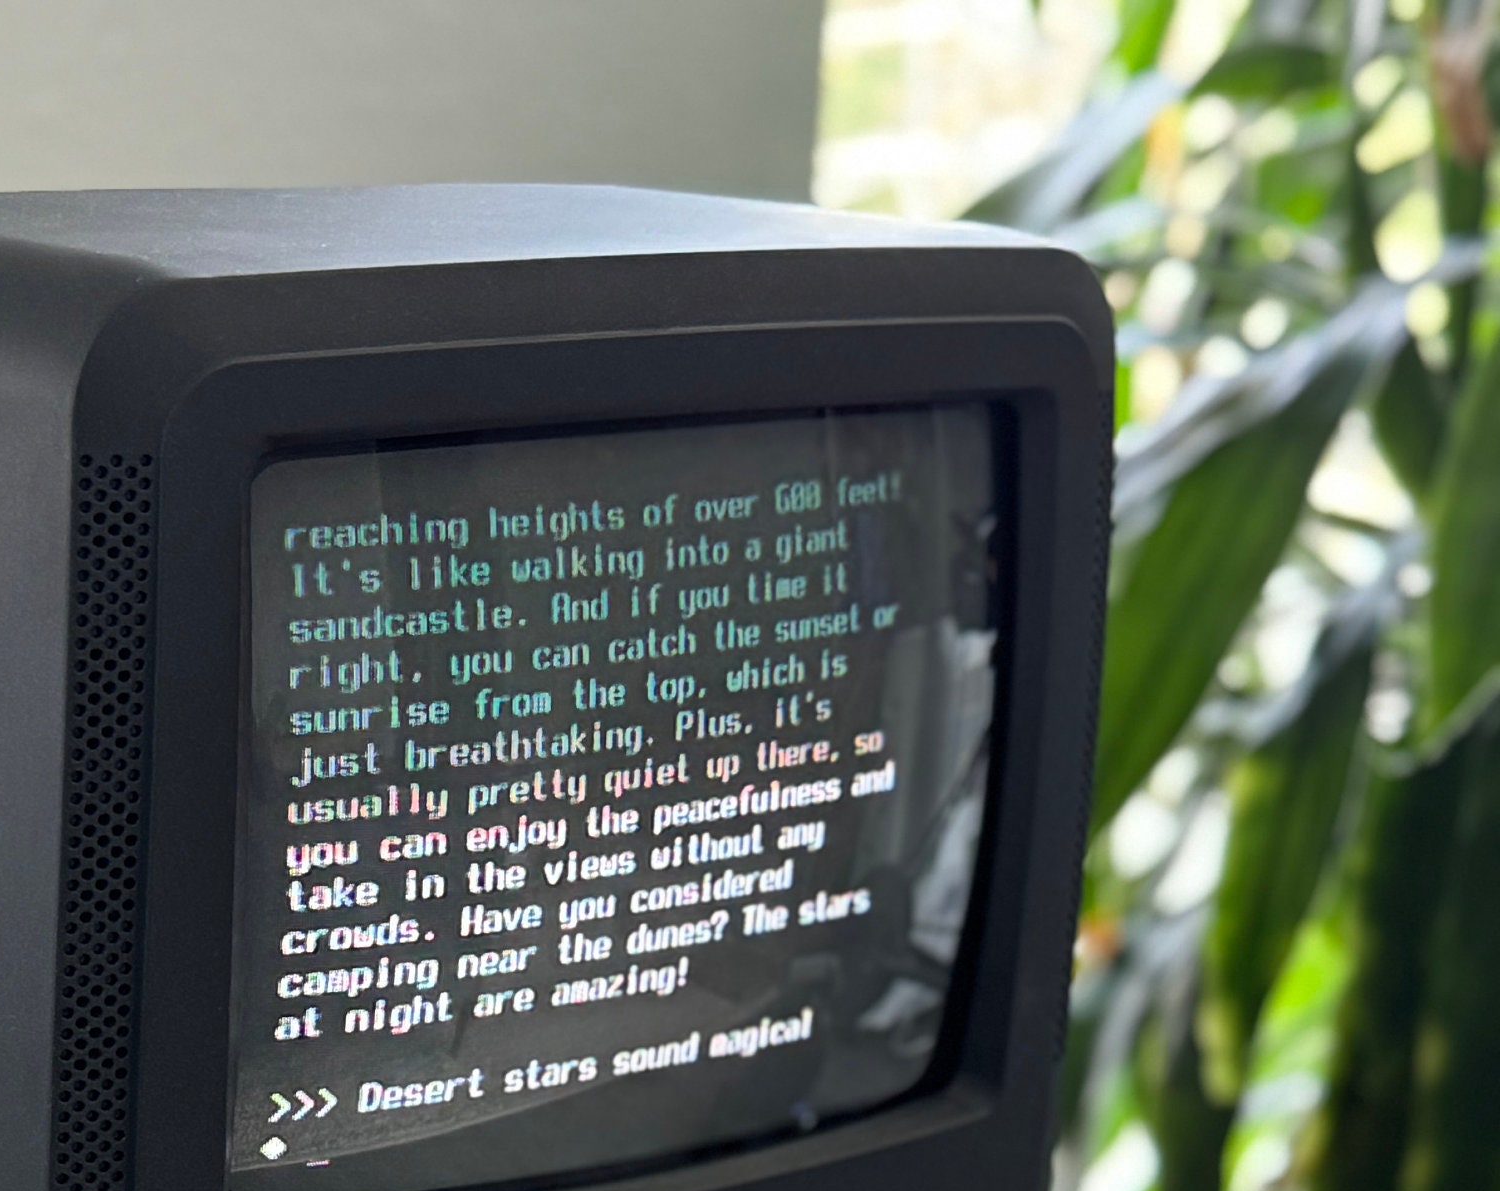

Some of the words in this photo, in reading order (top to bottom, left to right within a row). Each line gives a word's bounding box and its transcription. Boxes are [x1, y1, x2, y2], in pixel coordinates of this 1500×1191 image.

[284, 512, 470, 550] reaching
[488, 500, 625, 542] heights
[642, 493, 679, 528] of
[694, 494, 760, 523] over
[774, 480, 823, 515] 600
[837, 471, 901, 507] feet!
[288, 597, 528, 644] sandcastle.
[551, 587, 609, 626] And
[630, 582, 663, 618] if
[678, 584, 731, 620] you
[748, 571, 808, 604] time
[822, 562, 848, 597] it
[291, 557, 382, 599] It's
[409, 553, 492, 591] like
[511, 543, 646, 583] walking
[665, 533, 730, 572] into
[744, 536, 763, 562] a
[775, 519, 849, 565] giant
[288, 695, 451, 736] sunrise
[474, 687, 552, 720] from
[572, 677, 627, 711] the
[726, 653, 806, 693] which
[820, 648, 849, 681] is
[289, 650, 423, 694] right,
[450, 649, 514, 686] you
[531, 642, 592, 671] can
[607, 624, 697, 664] catch
[714, 618, 762, 652] the
[774, 603, 860, 644] sunset
[872, 602, 901, 630] or
[287, 782, 450, 825] usually
[466, 767, 588, 816] pretty
[603, 752, 691, 799] quiet
[705, 753, 741, 784] up
[853, 729, 886, 757] so
[290, 741, 381, 788] just
[774, 690, 833, 729] it's
[286, 839, 360, 877] you
[379, 830, 448, 862] can
[465, 814, 569, 855] enjoy
[586, 804, 640, 839] the
[651, 776, 843, 836] peacefulness
[850, 758, 897, 798] and
[280, 913, 437, 956] crowds.
[459, 903, 544, 938] Have
[558, 893, 618, 930] you
[629, 857, 795, 915] considered
[286, 875, 381, 912] take
[404, 868, 446, 902] in
[466, 860, 527, 895] the
[542, 849, 638, 887] views
[649, 823, 765, 872] without
[776, 820, 827, 853] any
[276, 956, 440, 1000] camping
[456, 944, 538, 980] near
[557, 931, 613, 966] the
[625, 909, 731, 956] dunes?
[741, 901, 791, 937] The
[797, 887, 872, 927] stars
[273, 1005, 324, 1042] at
[343, 990, 455, 1037] night
[472, 986, 536, 1019] are
[550, 955, 690, 1007] amazing!
[356, 1066, 487, 1114] Desert
[503, 1056, 599, 1094] stars
[611, 1030, 701, 1076] sound
[707, 1004, 815, 1059] magical
